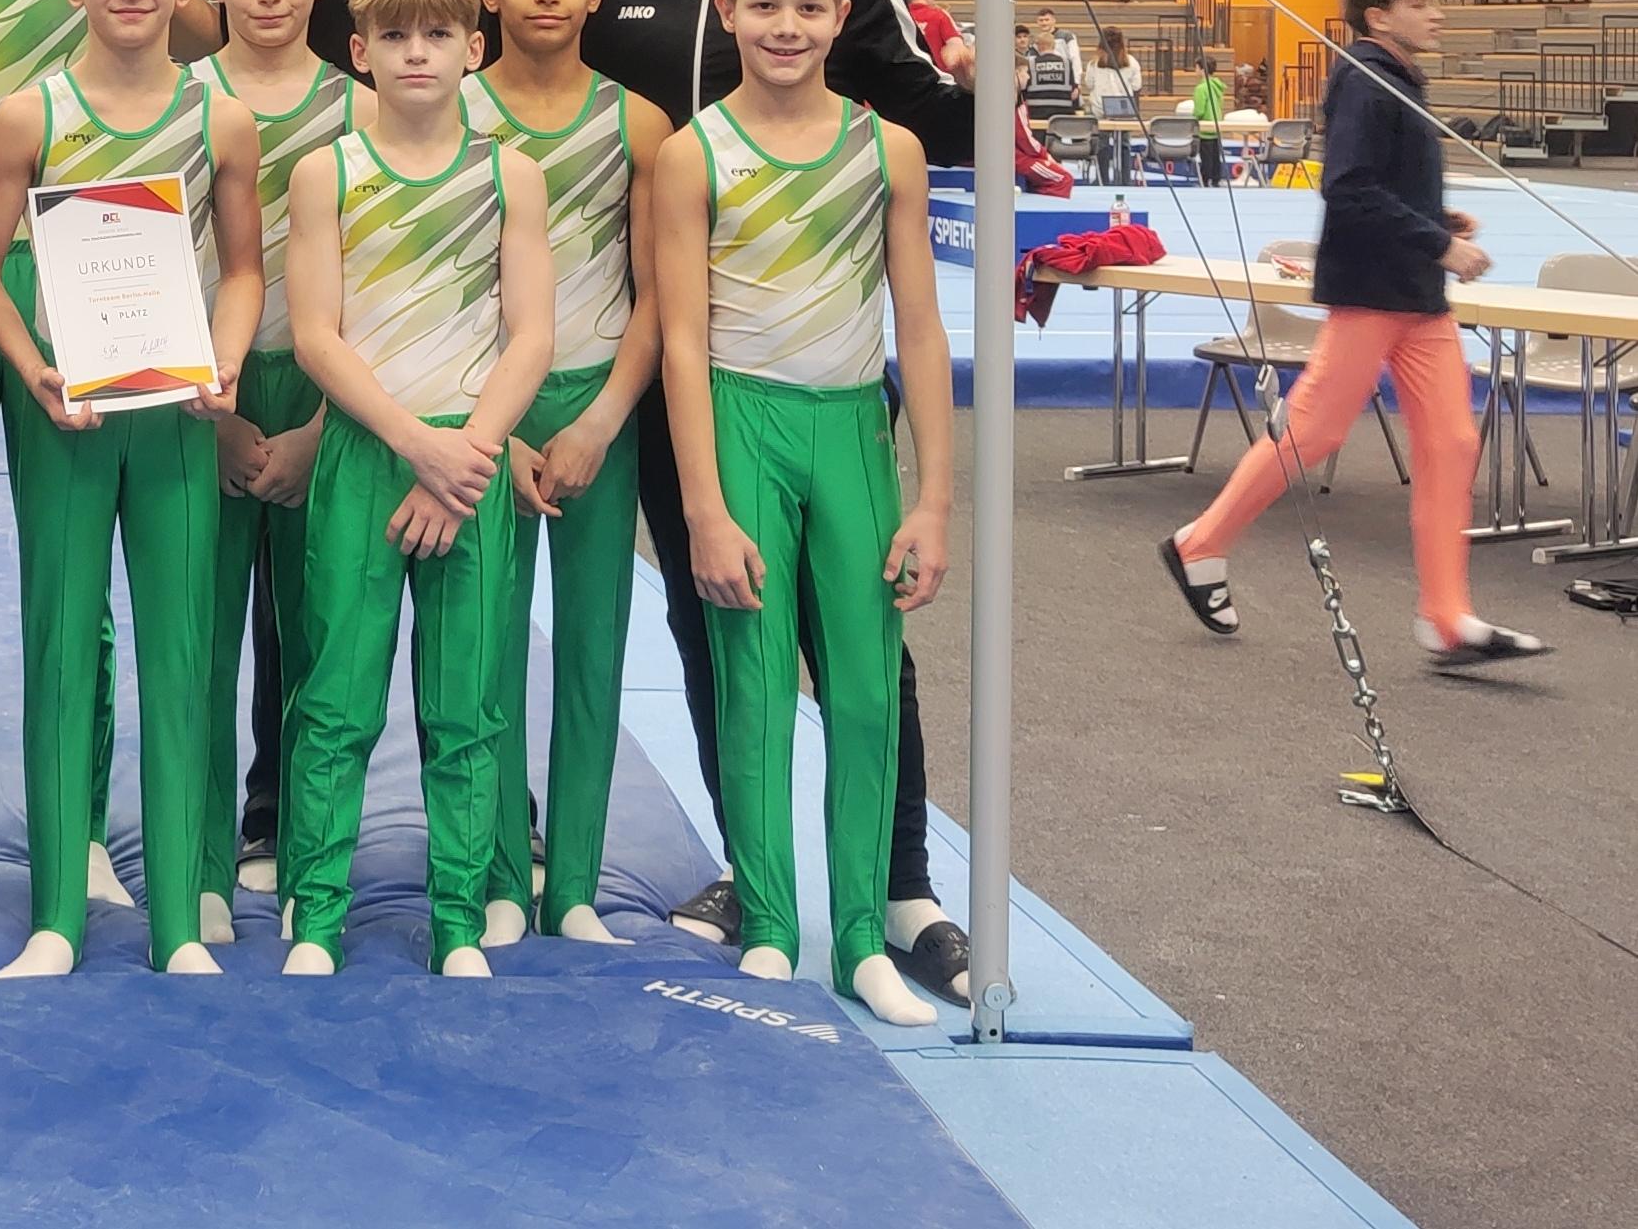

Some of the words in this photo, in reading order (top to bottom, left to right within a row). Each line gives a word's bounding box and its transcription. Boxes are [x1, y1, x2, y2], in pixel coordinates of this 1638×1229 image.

[618, 6, 656, 20] JAKO
[935, 216, 975, 251] SPIETH
[77, 254, 157, 276] URKUNDE
[100, 311, 109, 325] 4
[119, 308, 149, 319] PLATZ
[643, 980, 797, 1026] SPIETH
